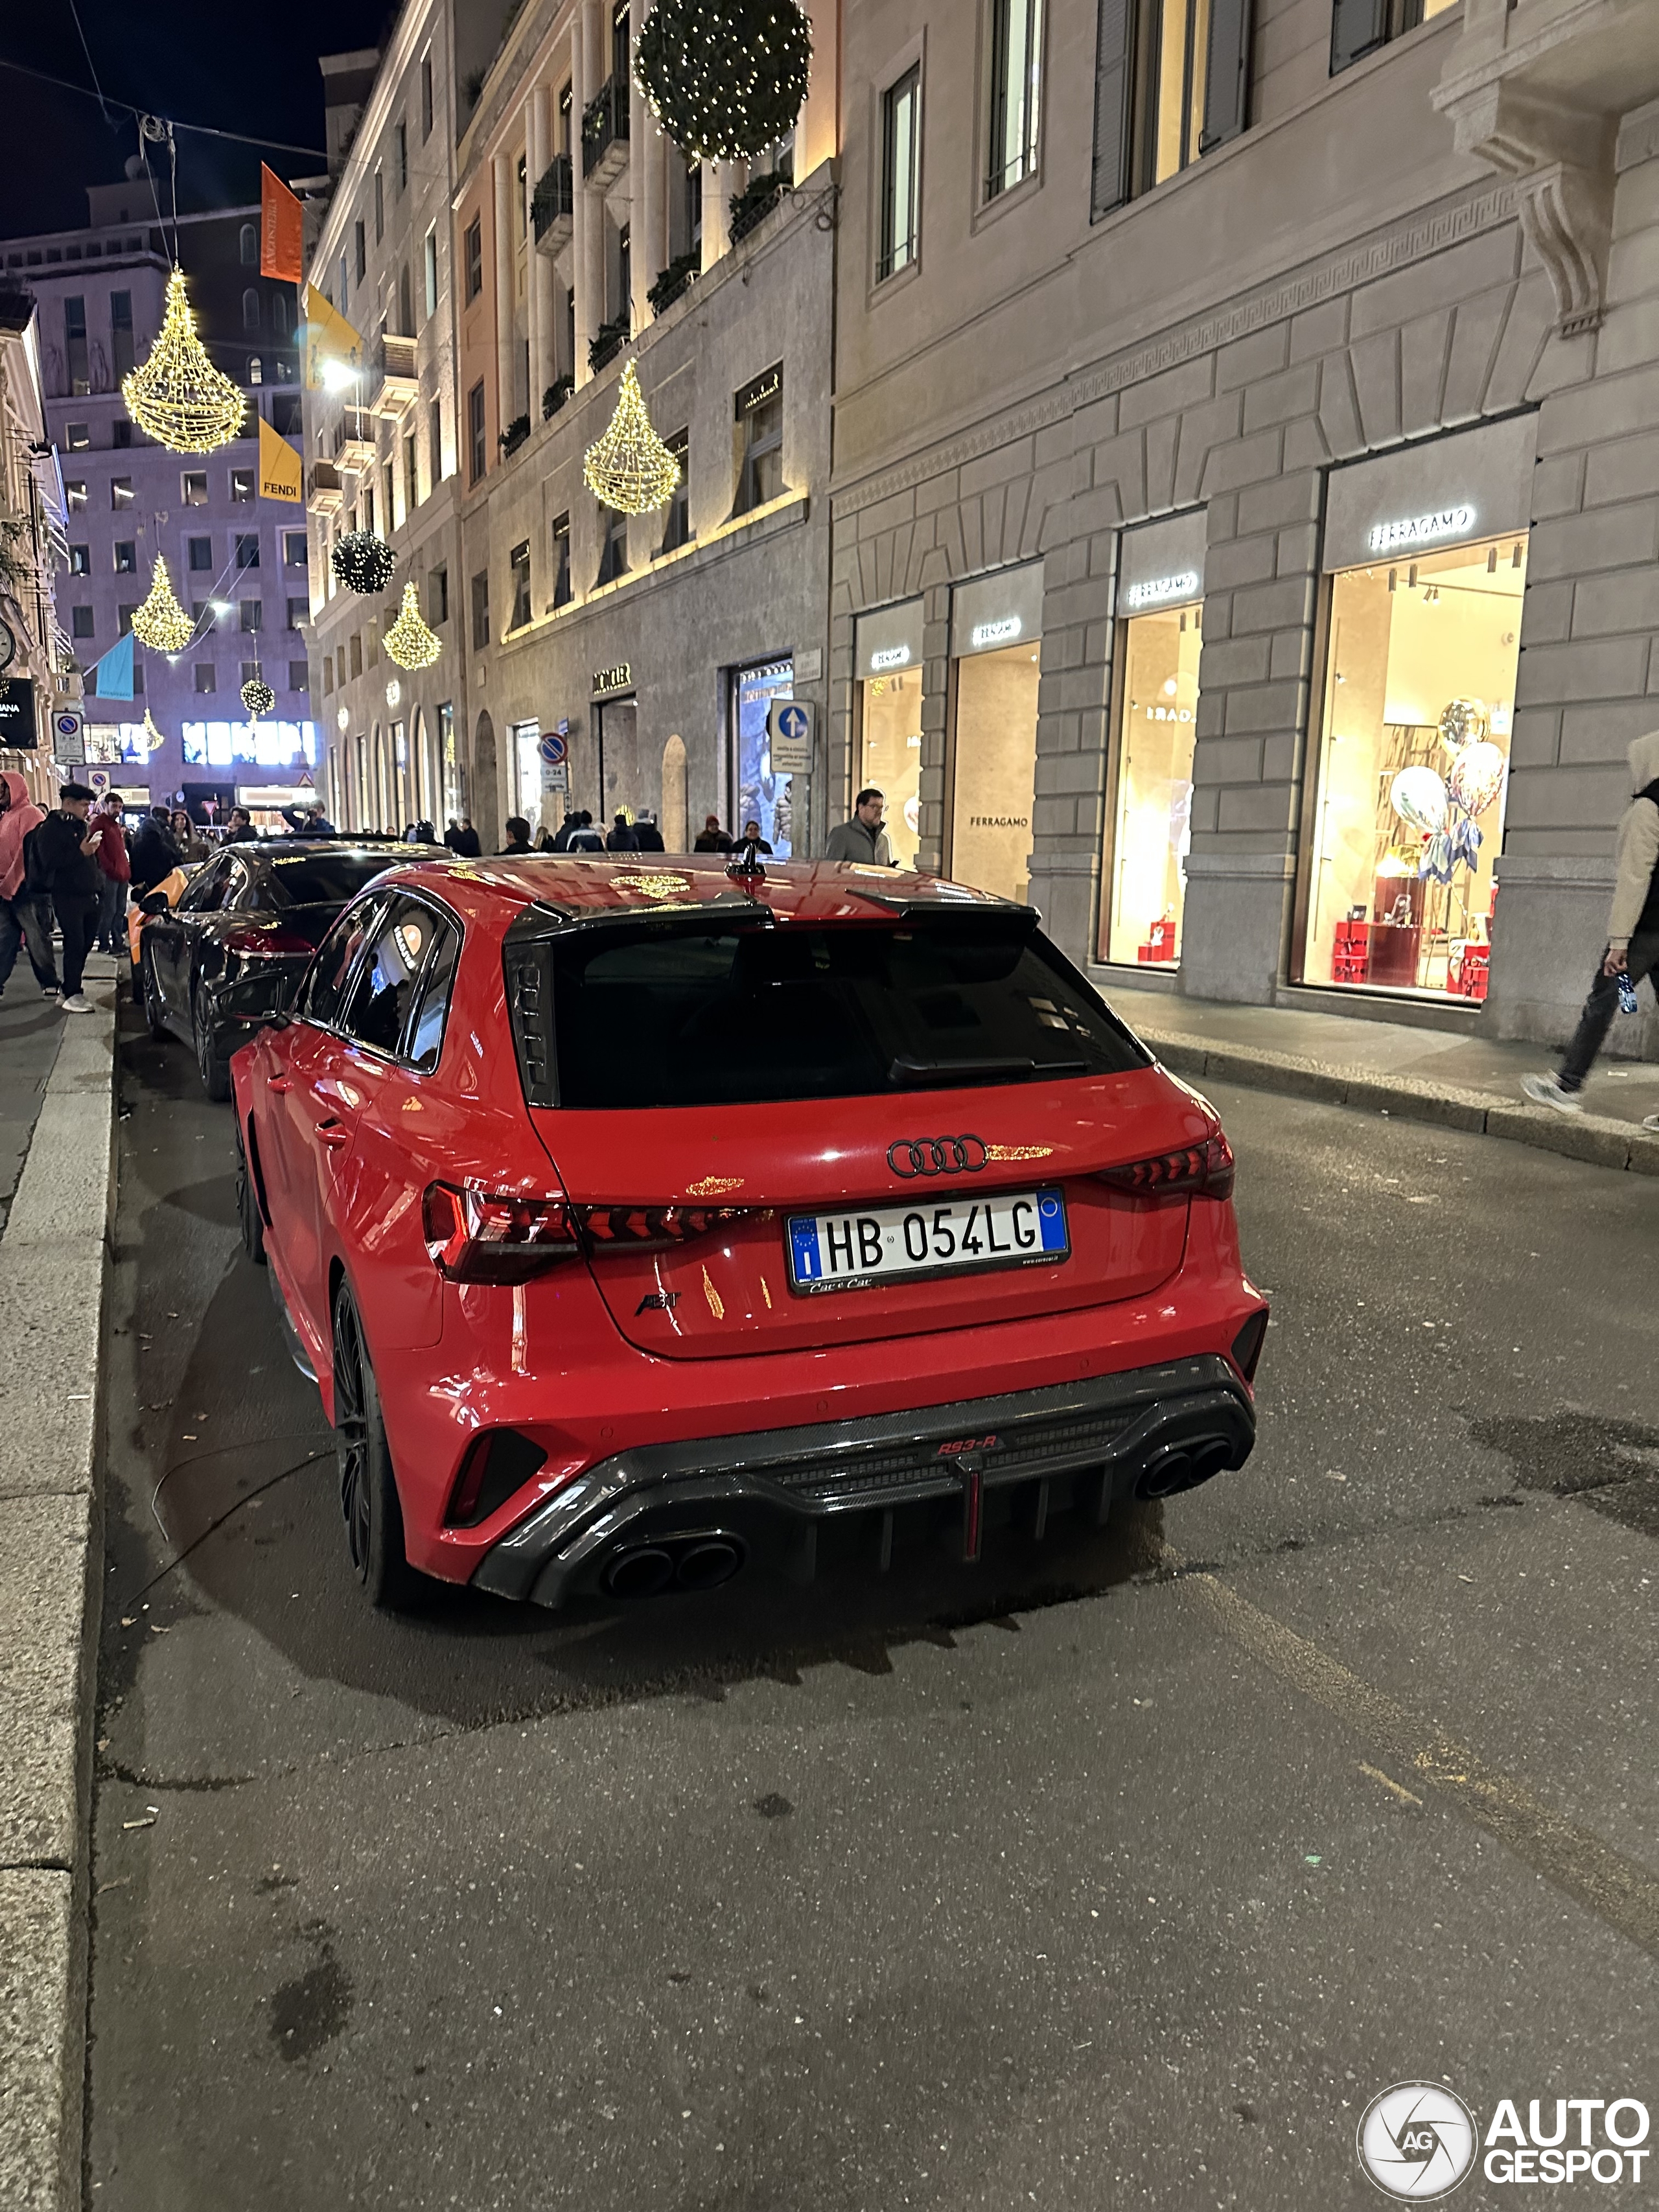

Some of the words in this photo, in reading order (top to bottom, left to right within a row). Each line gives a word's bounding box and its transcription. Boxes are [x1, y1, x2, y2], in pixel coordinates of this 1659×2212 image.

[264, 482, 296, 497] FENDI
[1369, 509, 1468, 548] FERRAGAMO
[970, 817, 1028, 828] FERRAGAMO
[826, 1218, 883, 1273] HB
[903, 1201, 1036, 1261] 054LG
[937, 1435, 997, 1455] RS3-R
